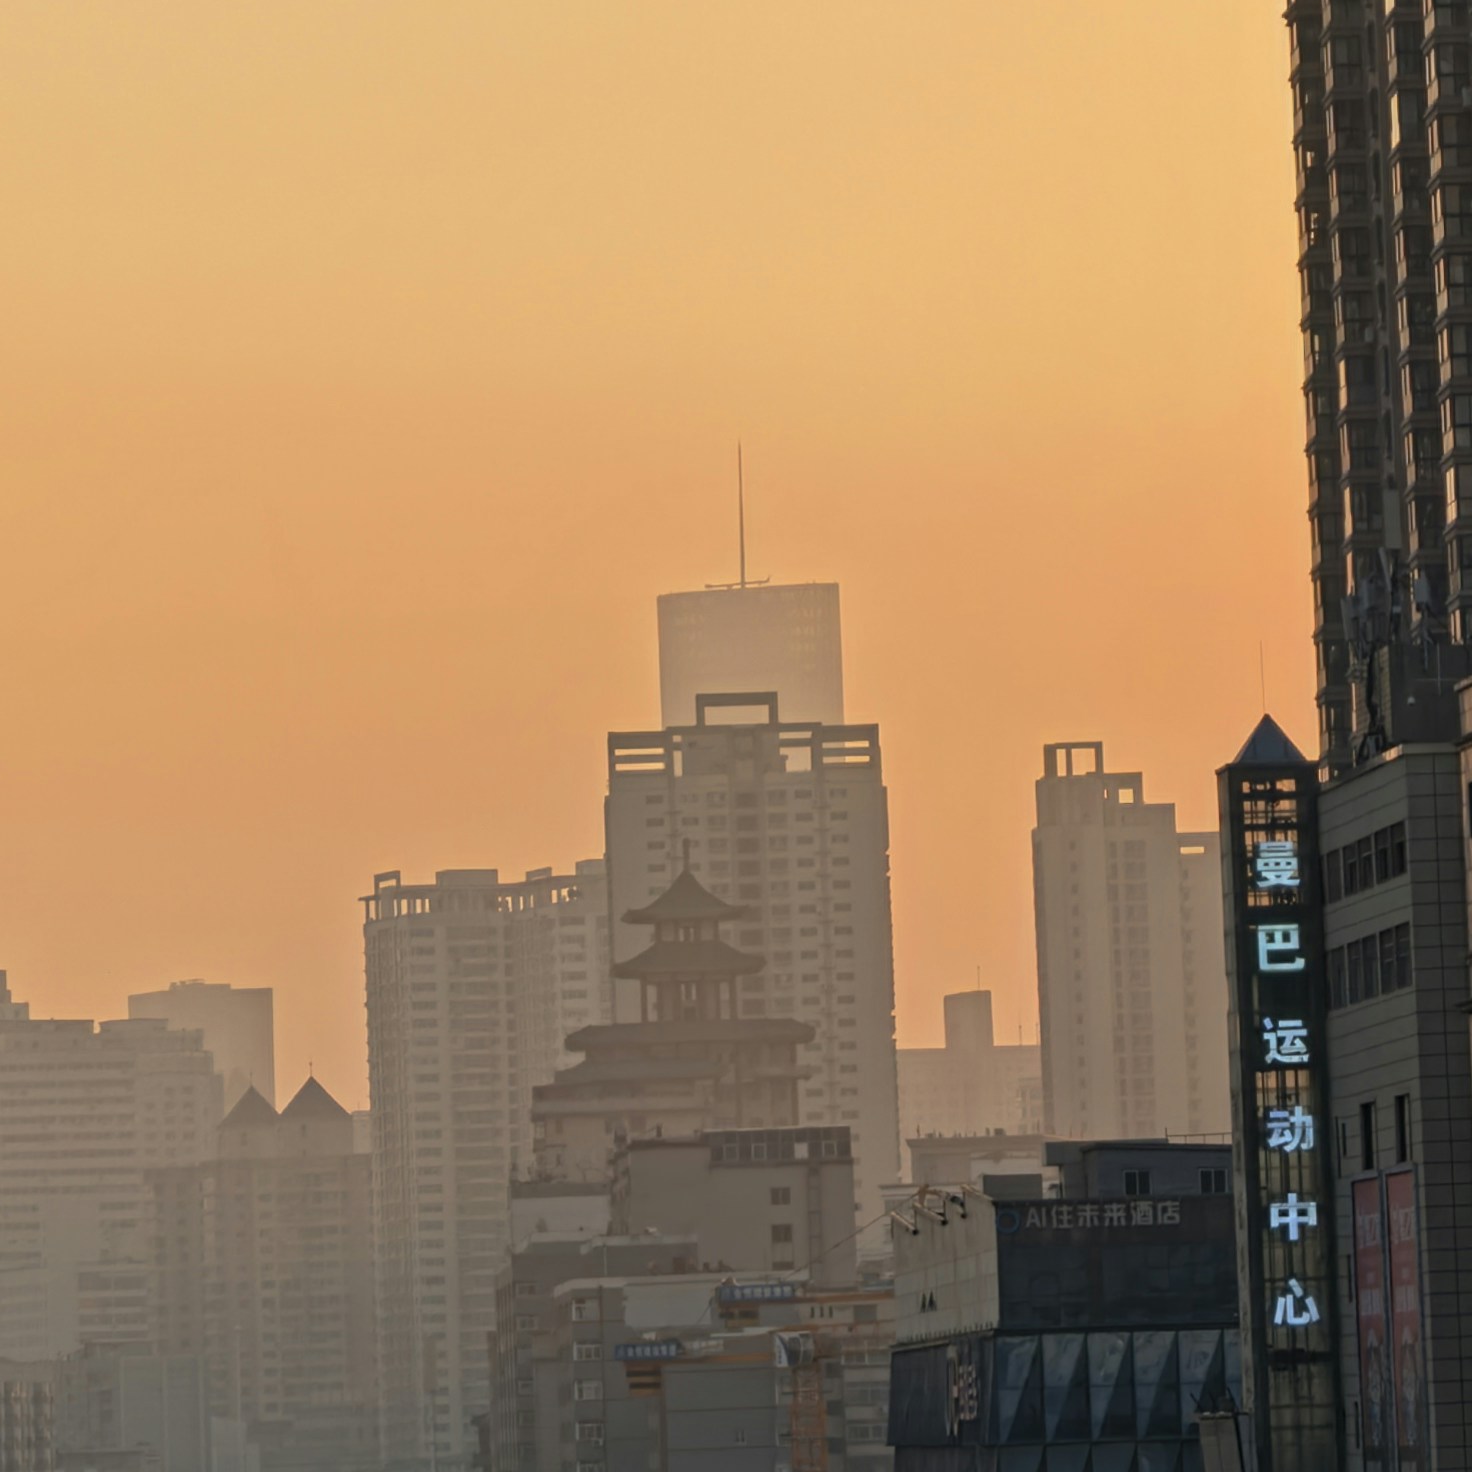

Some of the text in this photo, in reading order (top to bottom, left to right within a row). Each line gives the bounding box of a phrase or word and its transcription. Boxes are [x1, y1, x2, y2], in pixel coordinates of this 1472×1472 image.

[1253, 839, 1321, 1328] 曼巴运动中心
[1025, 1200, 1181, 1229] AI住未来酒店
